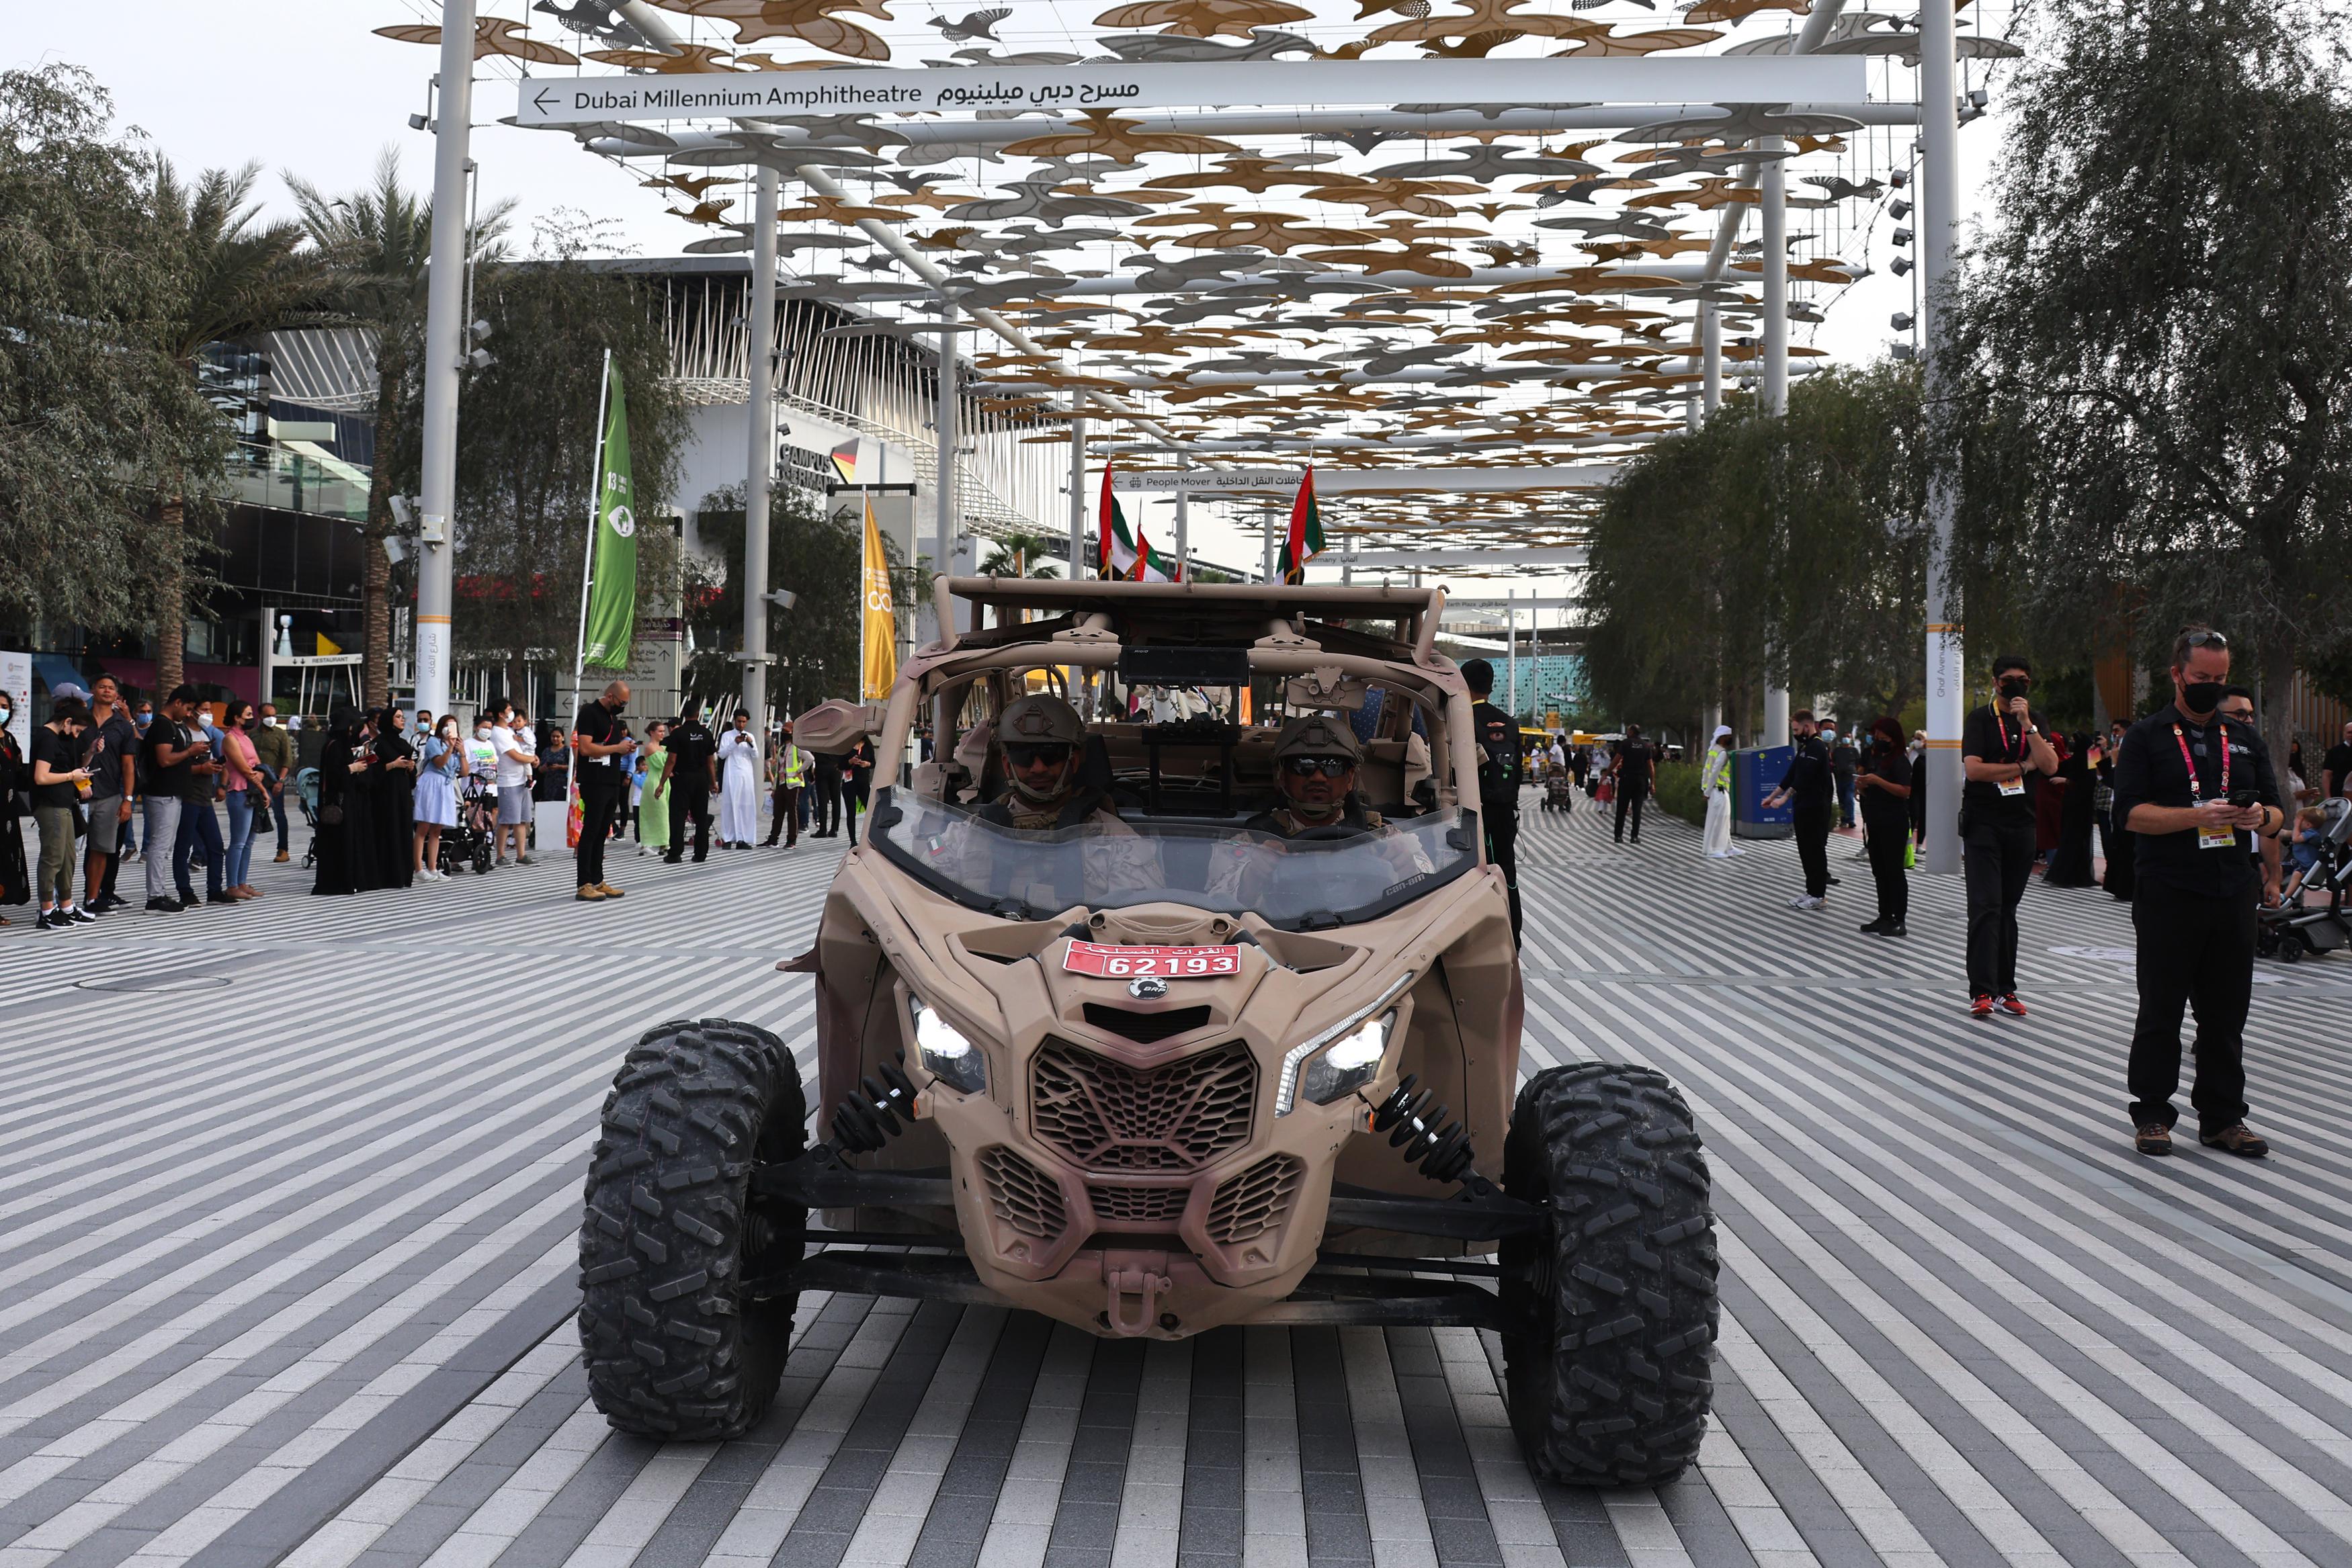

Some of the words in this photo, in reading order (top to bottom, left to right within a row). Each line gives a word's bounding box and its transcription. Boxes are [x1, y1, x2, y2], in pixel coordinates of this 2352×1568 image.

[575, 89, 637, 110] Dubai
[644, 87, 762, 107] Millennium
[766, 83, 922, 109] Amphitheatre
[937, 81, 1023, 106] ميلينيوم
[1030, 83, 1074, 107] دبي
[1079, 83, 1140, 103] مسرح
[780, 443, 831, 473] CAMPUS
[607, 471, 617, 490] 13
[1146, 478, 1179, 488] People
[1181, 478, 1211, 486] Mover
[1216, 476, 1249, 487] الداخلية
[1251, 476, 1273, 487] النقل
[428, 633, 438, 654] شارع
[1937, 677, 1945, 697] Ghaf
[1386, 873, 1425, 896] can-am
[1084, 944, 1160, 955] المسلحة
[1172, 947, 1224, 956] القوات
[1109, 957, 1233, 975] 62193
